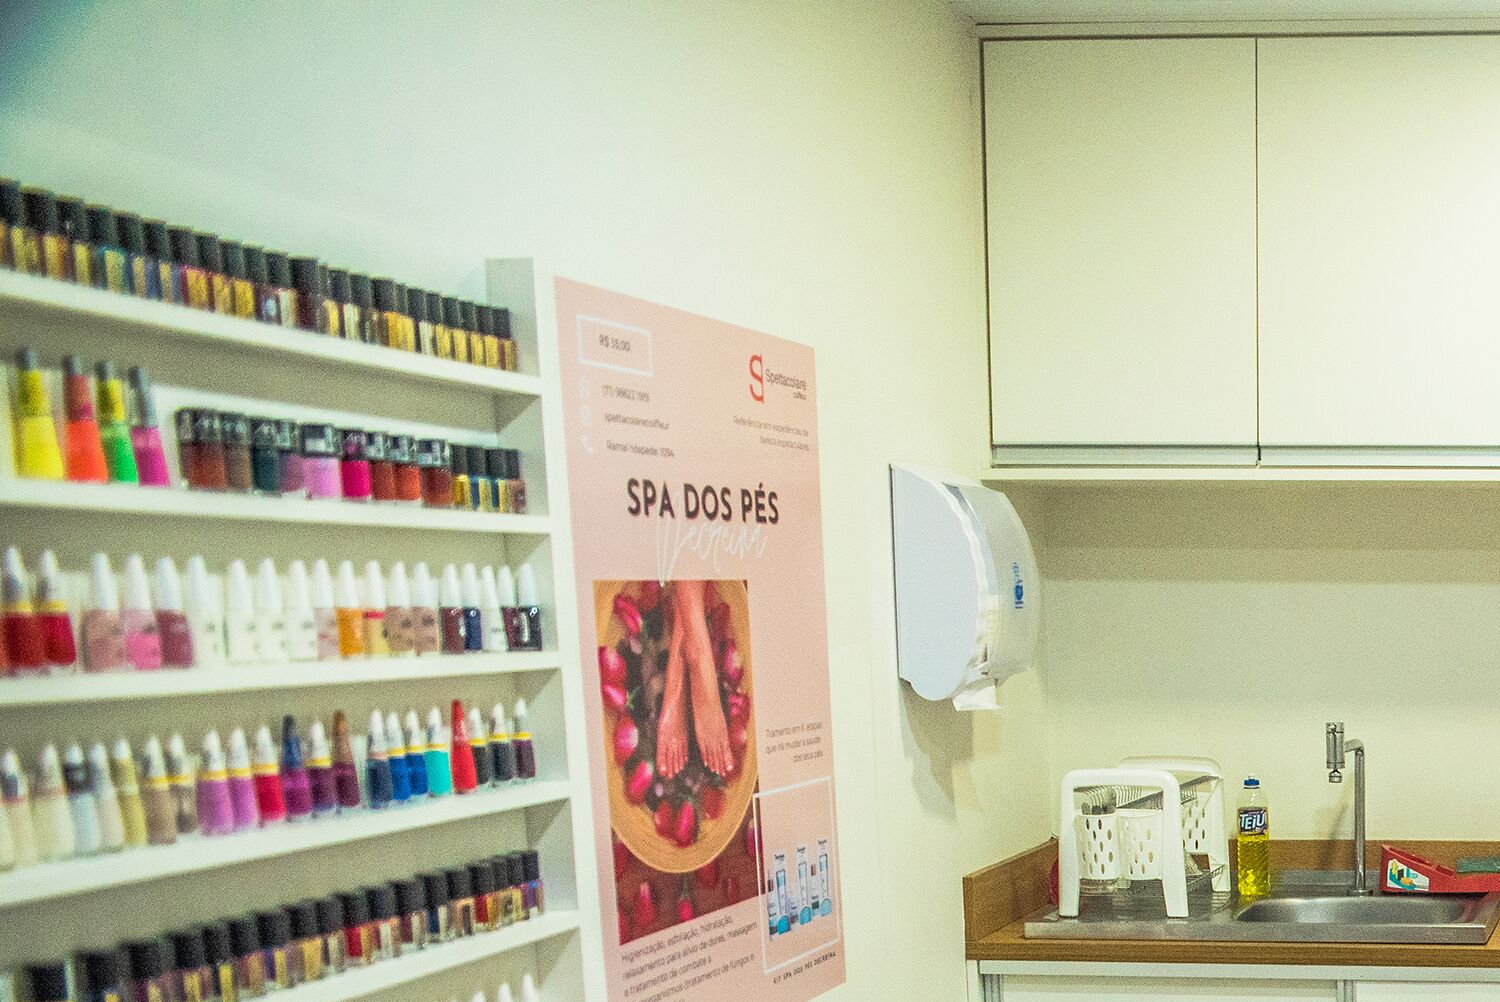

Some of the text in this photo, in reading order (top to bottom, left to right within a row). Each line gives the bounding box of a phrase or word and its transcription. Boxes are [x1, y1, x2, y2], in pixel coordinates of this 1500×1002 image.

[627, 478, 779, 524] SPA DOS PÉS
[629, 973, 667, 994] tratamento
[669, 969, 678, 978] de
[679, 958, 706, 975] combate
[666, 951, 681, 965] para
